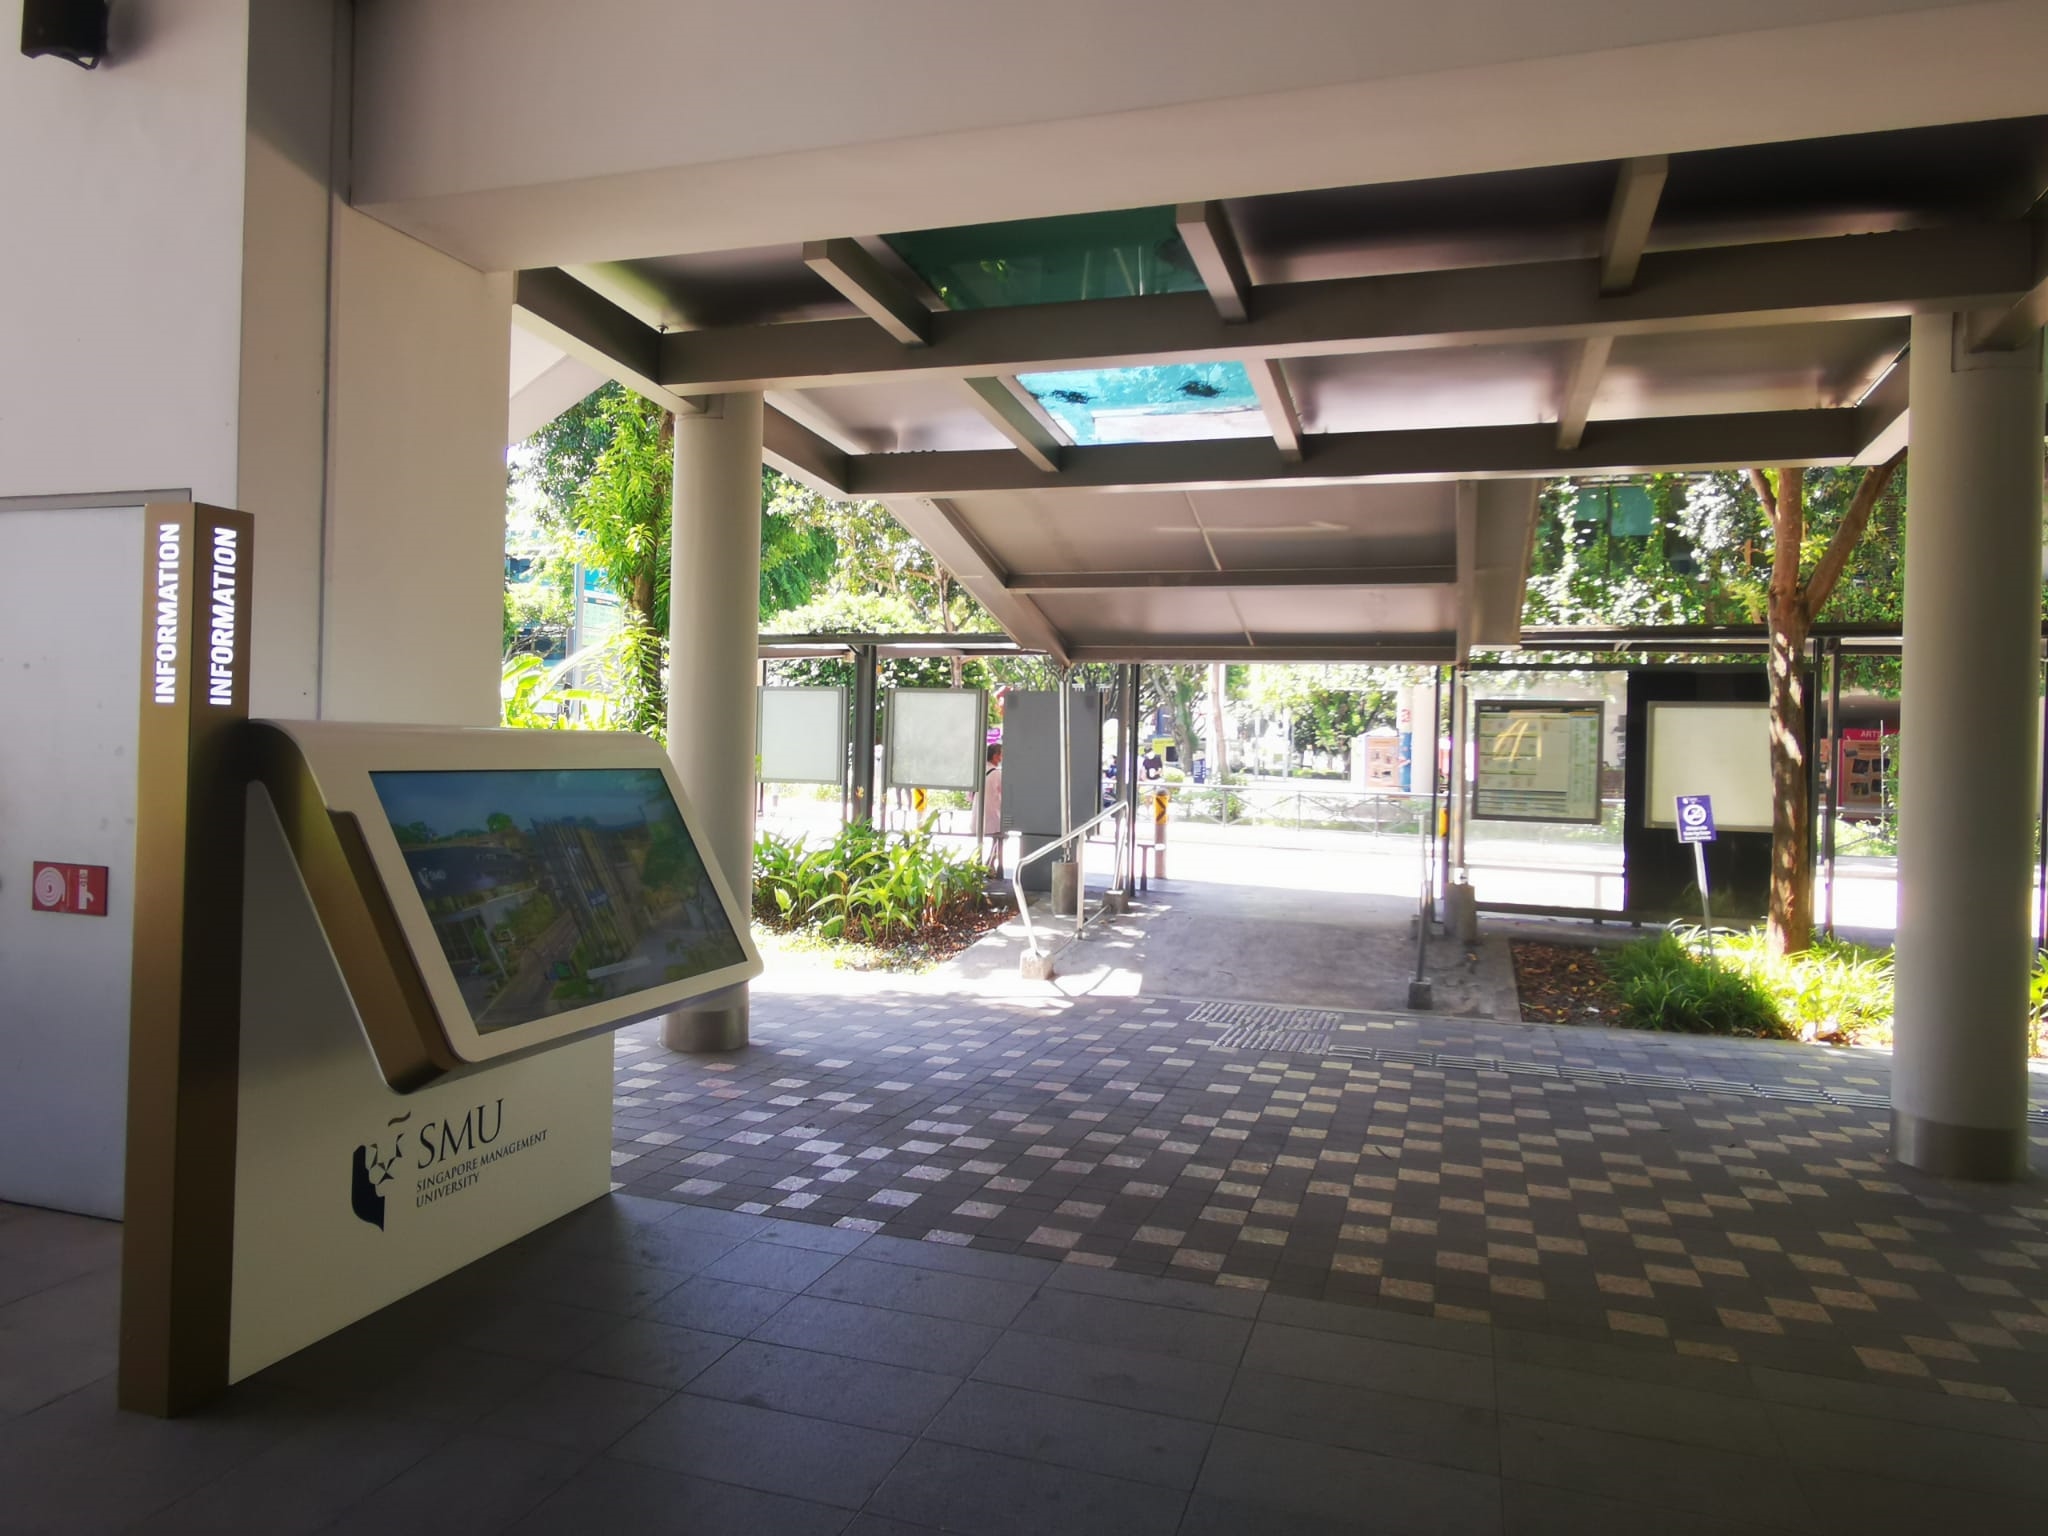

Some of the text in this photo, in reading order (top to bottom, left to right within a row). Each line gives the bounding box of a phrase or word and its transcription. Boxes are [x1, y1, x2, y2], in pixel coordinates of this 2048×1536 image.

[155, 523, 180, 703] INFORMATION
[210, 528, 237, 705] INFORMATION
[417, 1130, 548, 1192] SINGAPORE MANAGEMENT
[418, 1098, 503, 1169] SMU
[417, 1173, 479, 1207] UNIVERSITY
